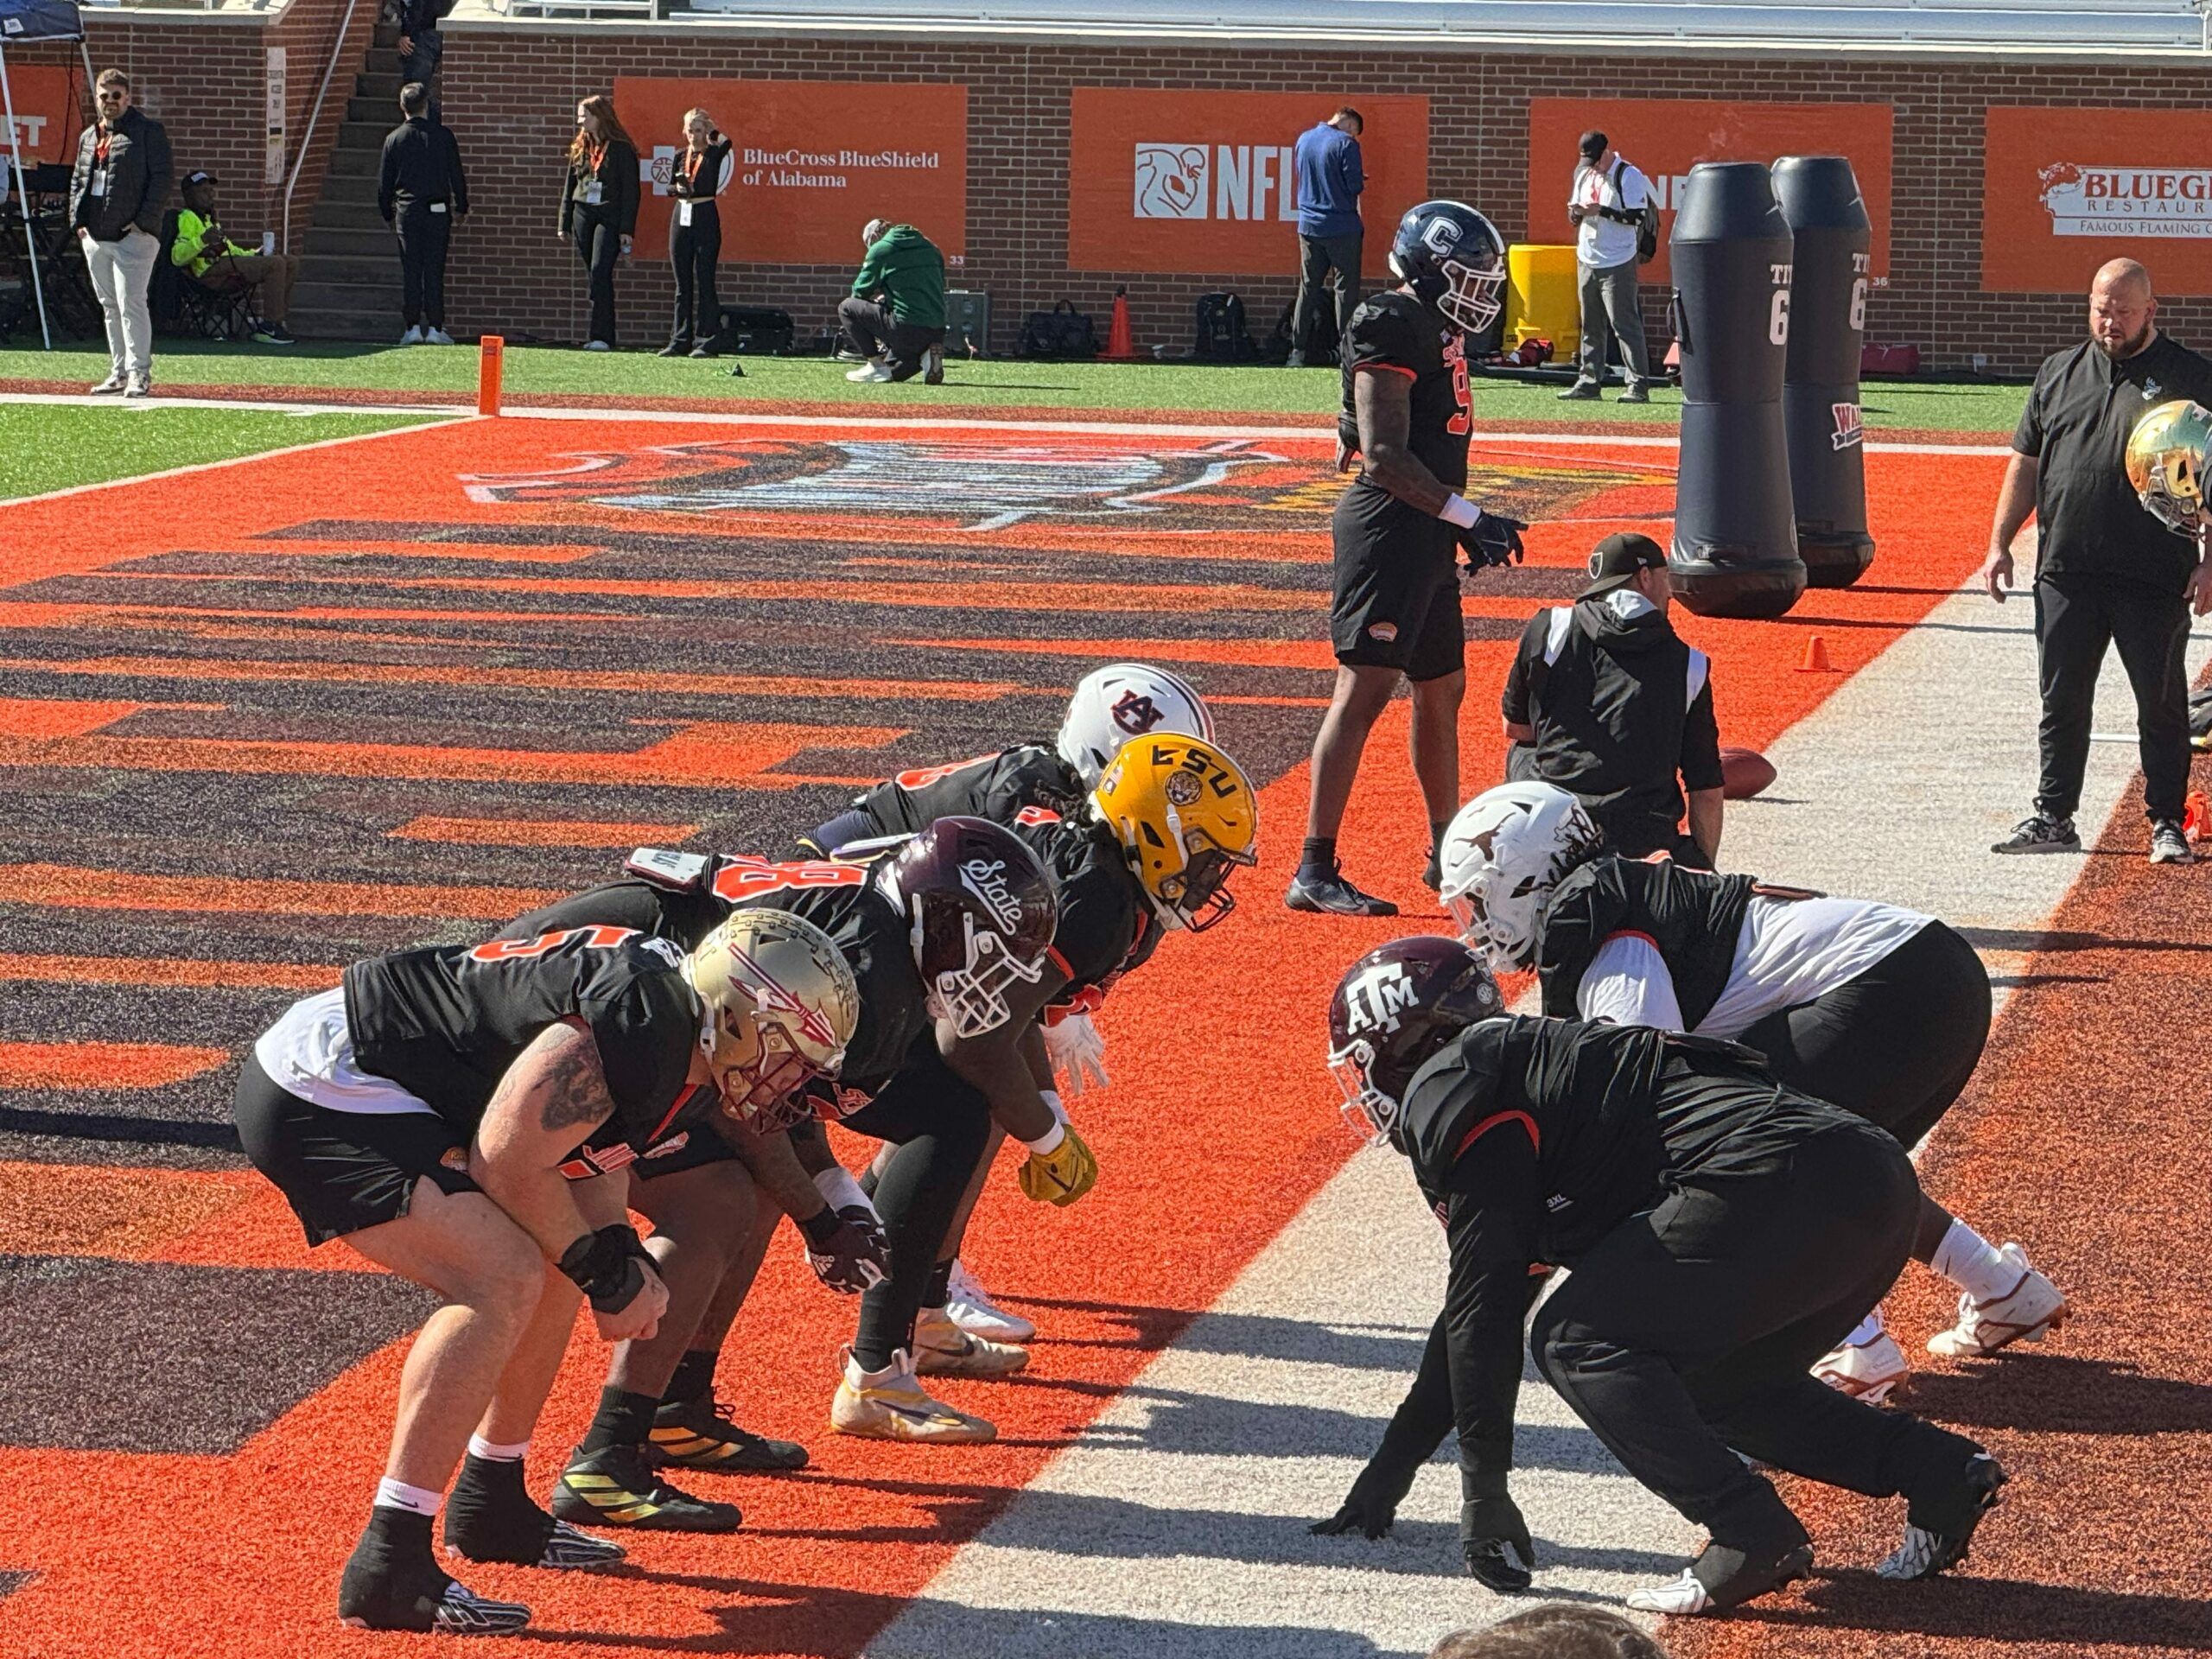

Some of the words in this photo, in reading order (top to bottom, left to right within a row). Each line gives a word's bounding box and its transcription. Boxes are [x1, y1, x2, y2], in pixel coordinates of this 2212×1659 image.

[743, 149, 836, 166] BlueCross
[839, 150, 939, 168] BlueShield
[742, 171, 762, 186] of
[766, 170, 847, 188] Alabama
[1217, 145, 1300, 221] NFL
[2085, 175, 2212, 200] BLUEG
[1421, 216, 1464, 257] C
[2080, 220, 2134, 233] FAMOUS
[2140, 221, 2201, 234] FLAMING
[1852, 253, 1871, 273] TI
[1872, 276, 1889, 286] 36
[1850, 278, 1868, 330] 6
[1770, 289, 1790, 346] 6
[957, 859, 1023, 936] State
[1547, 1193, 1567, 1208] 3XL
